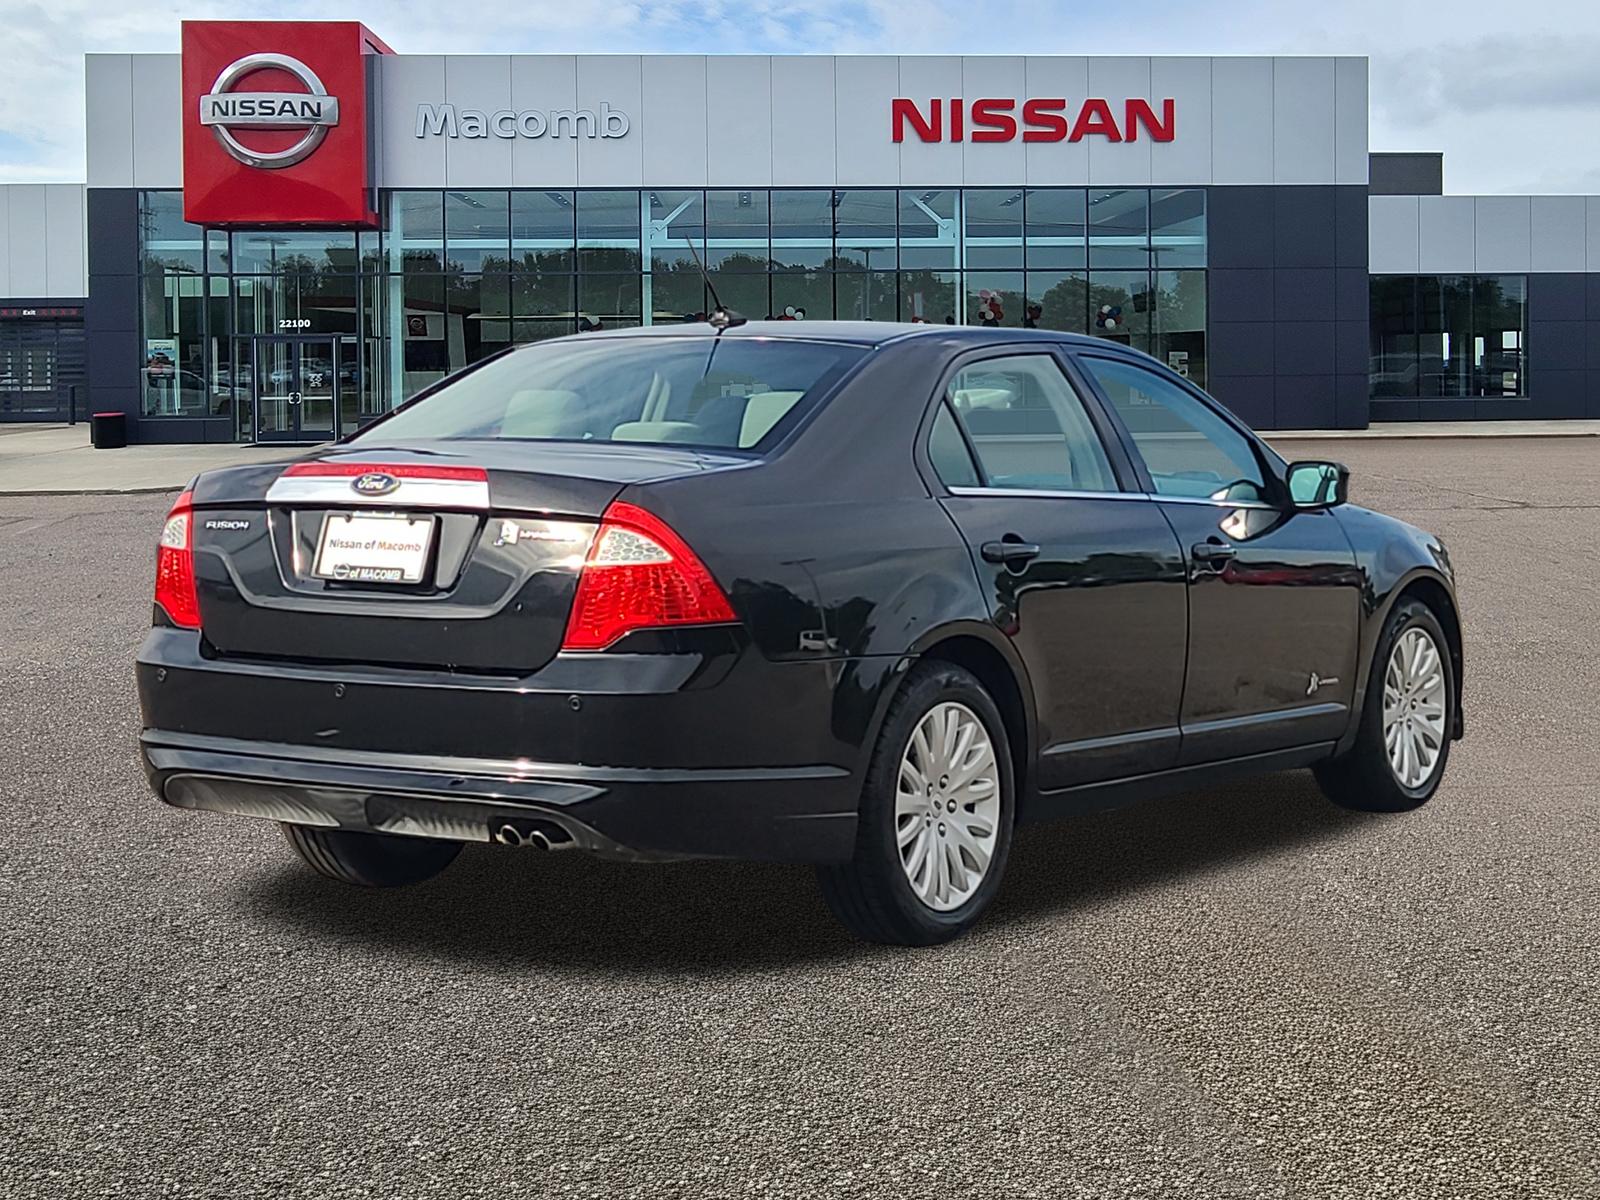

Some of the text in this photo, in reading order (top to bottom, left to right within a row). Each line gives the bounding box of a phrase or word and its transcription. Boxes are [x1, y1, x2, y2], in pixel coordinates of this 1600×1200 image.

[212, 100, 322, 117] NISSAN
[416, 102, 630, 139] Macomb
[892, 98, 1175, 143] NISSAN
[279, 319, 311, 328] 22100
[357, 475, 388, 489] Ford
[205, 520, 249, 530] FUSION
[329, 539, 421, 552] Nissan of Macomb
[360, 568, 401, 580] MACOMB
